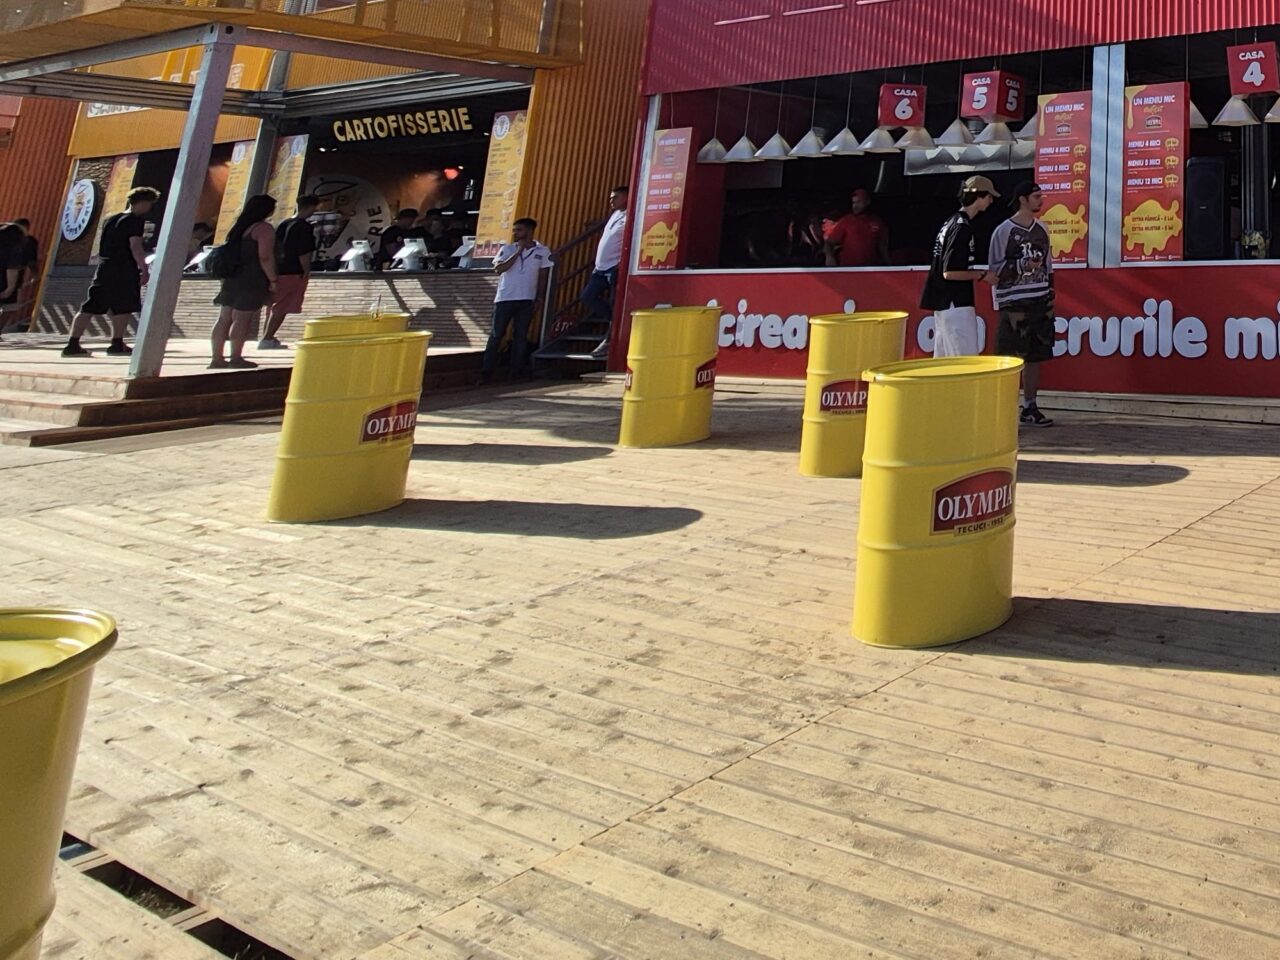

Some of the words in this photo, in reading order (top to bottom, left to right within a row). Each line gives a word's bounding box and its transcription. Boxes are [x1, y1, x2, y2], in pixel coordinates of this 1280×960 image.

[1238, 50, 1266, 61] CASA
[971, 76, 992, 86] CASA
[1005, 78, 1021, 89] CASA
[1242, 61, 1266, 87] 4
[894, 88, 918, 97] CASA
[971, 86, 988, 110] 5
[1005, 89, 1018, 112] 5
[894, 97, 914, 120] 6
[333, 107, 473, 142] CARTOFISSERIE
[822, 390, 867, 407] OLYMP
[938, 483, 1013, 521] OLYMPIA
[957, 522, 987, 534] TECUCI
